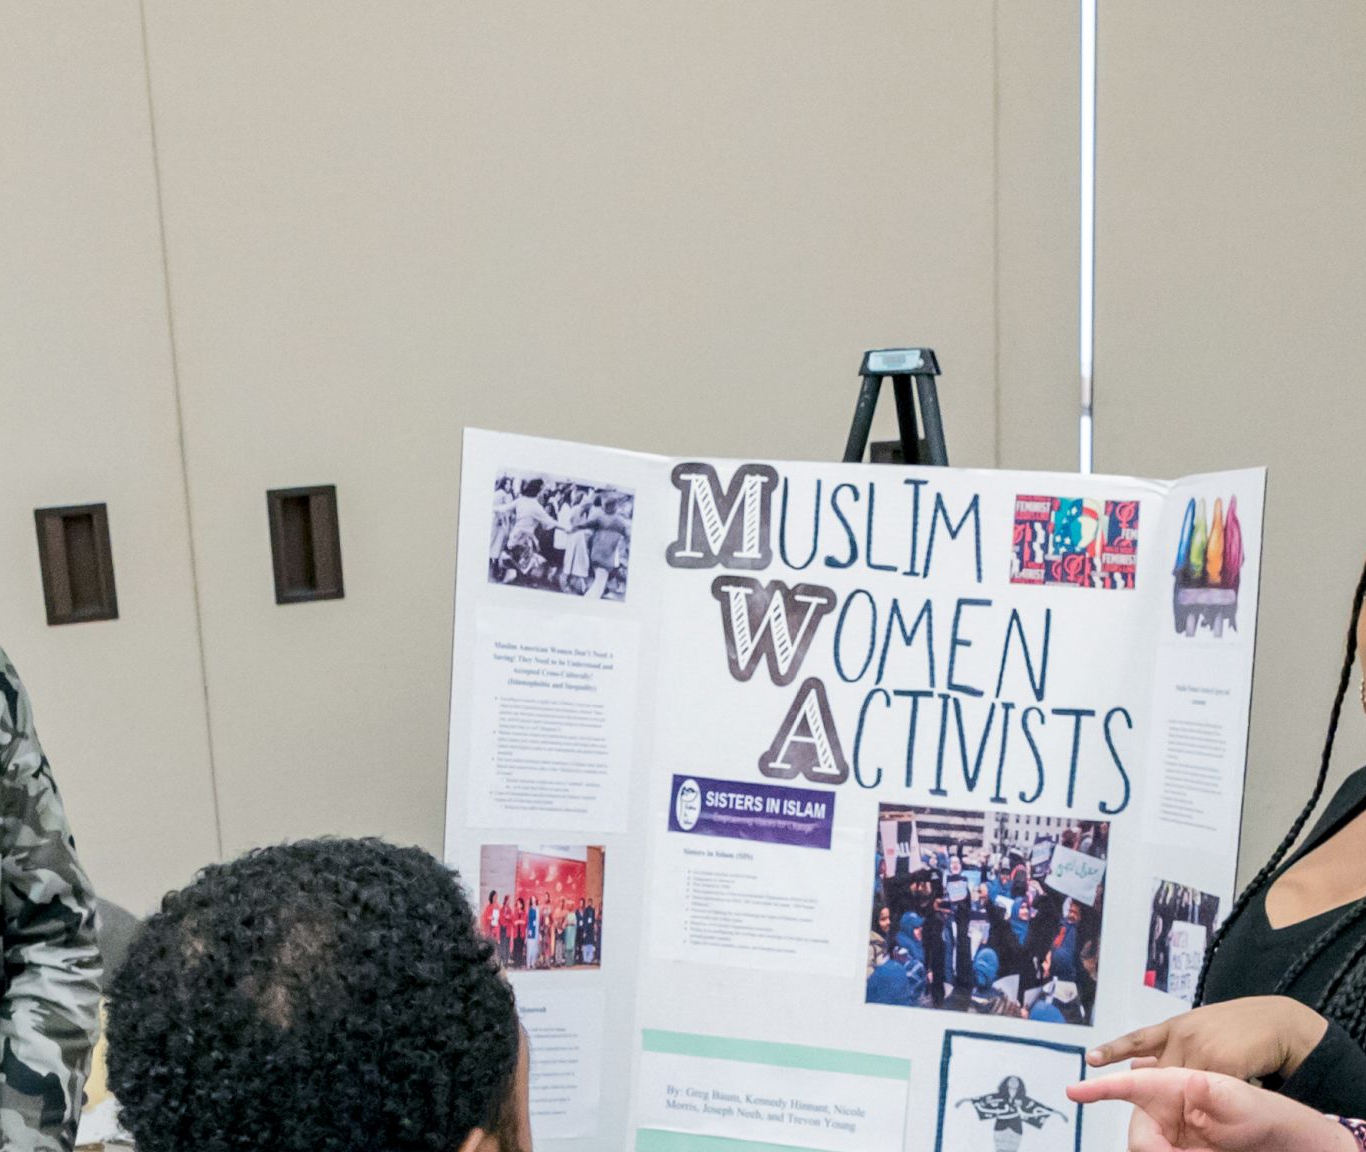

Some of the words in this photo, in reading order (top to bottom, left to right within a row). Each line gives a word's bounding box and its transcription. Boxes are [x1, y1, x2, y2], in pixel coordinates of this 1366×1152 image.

[1016, 500, 1051, 513] FEMINIST
[666, 462, 983, 584] MUSLIM
[1102, 552, 1137, 566] FEMINIST
[711, 574, 1051, 702] WOMEN
[758, 676, 1133, 815] ACTIVISTS
[705, 790, 764, 813] SISTERS
[766, 797, 781, 814] IN
[782, 800, 827, 820] ISLAM
[685, 1087, 710, 1101] Greg
[744, 1093, 788, 1110] Kennedy
[833, 1104, 866, 1118] Nicole
[702, 1103, 735, 1118] Joseph
[766, 1111, 785, 1123] and
[823, 1117, 857, 1133] Young
